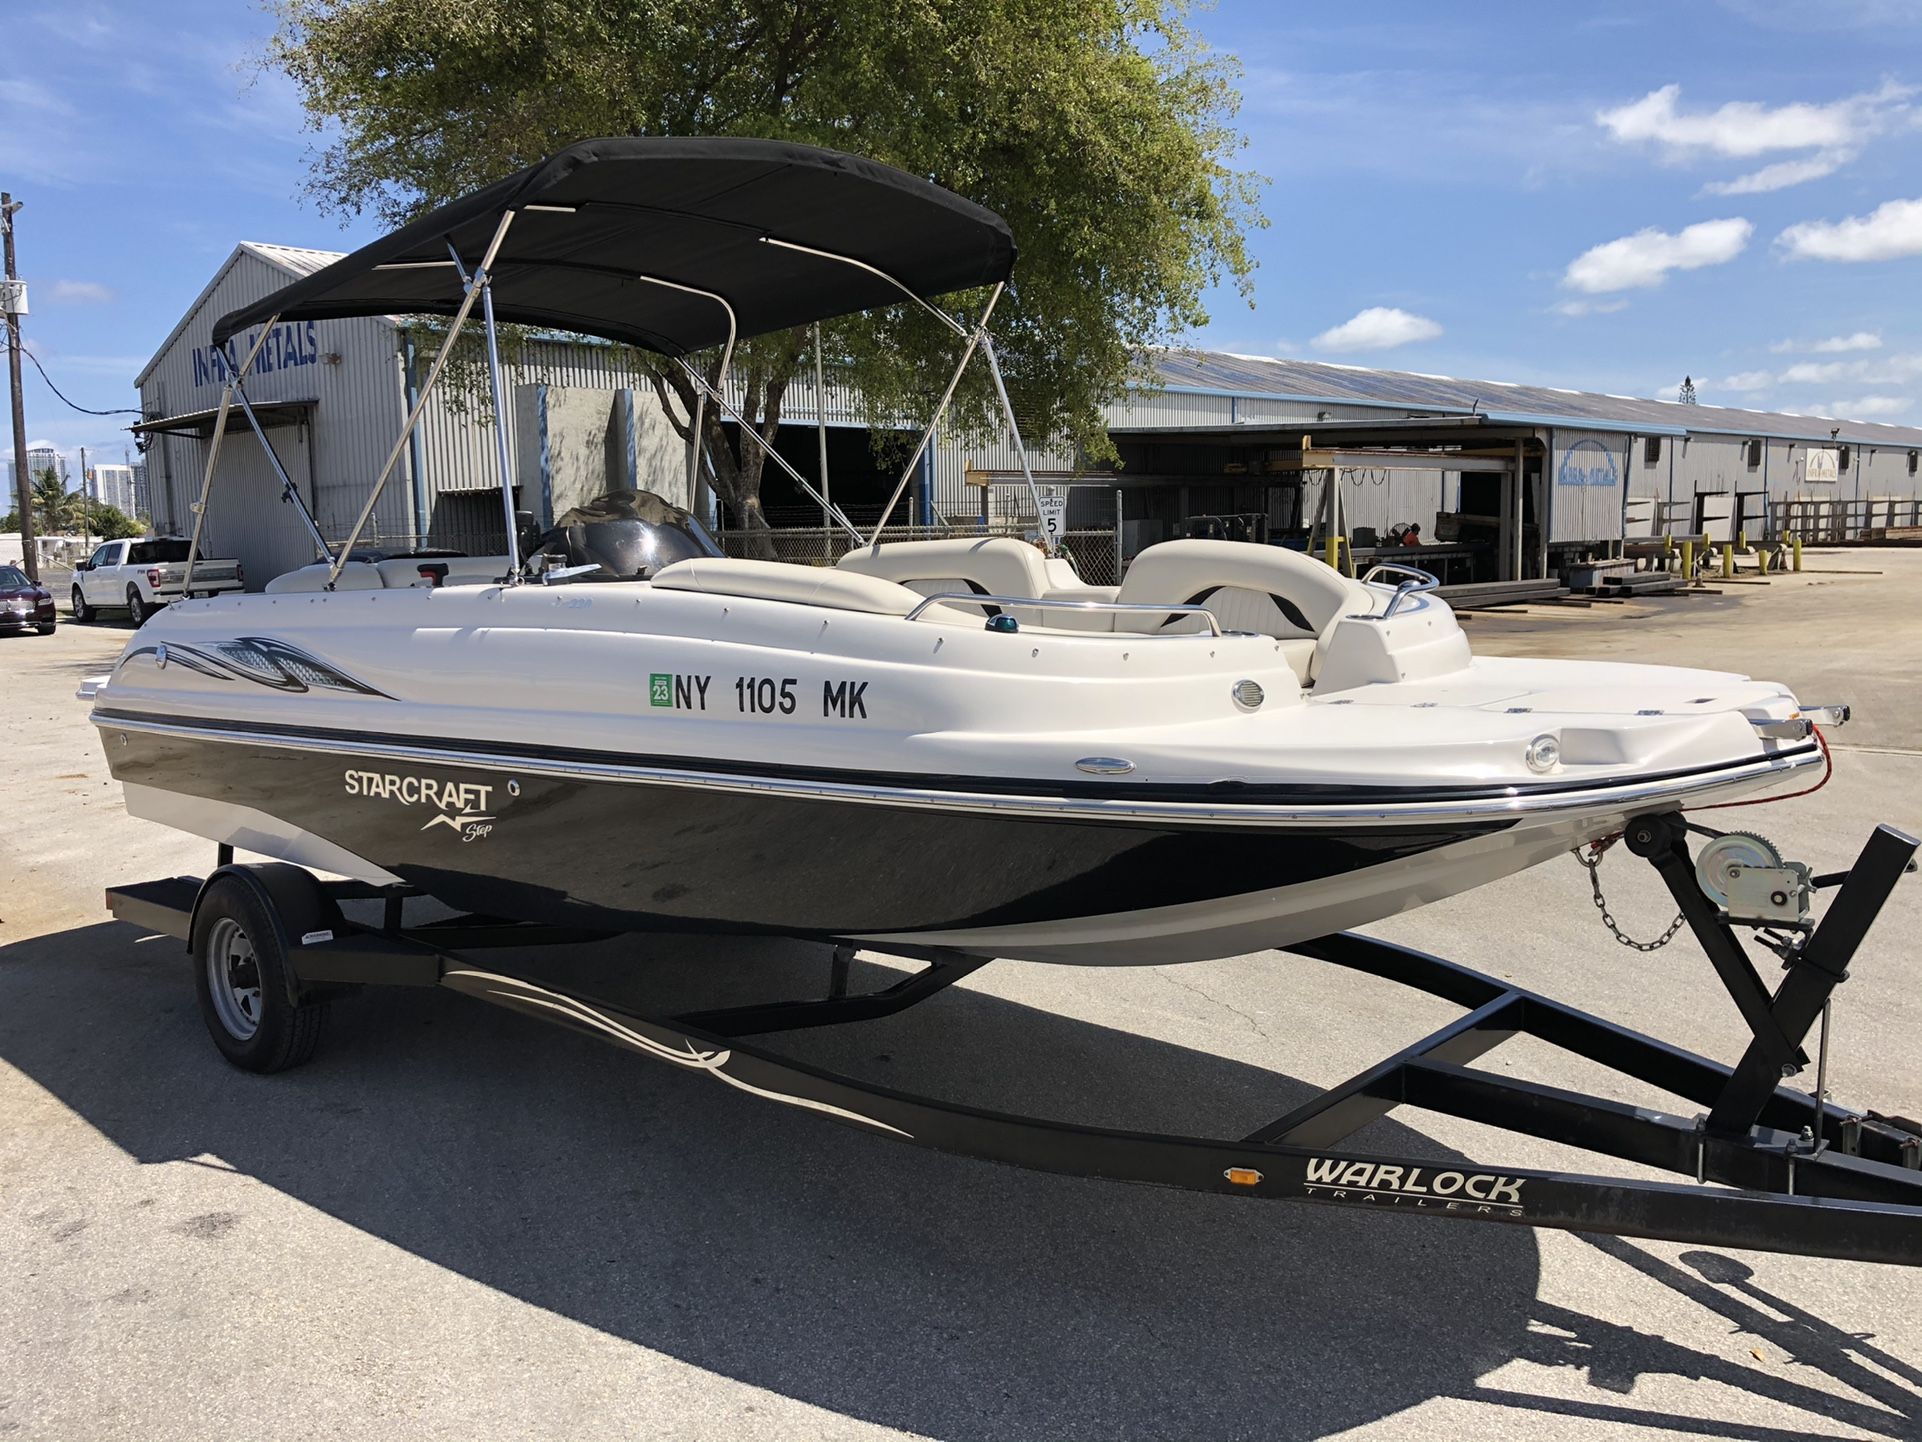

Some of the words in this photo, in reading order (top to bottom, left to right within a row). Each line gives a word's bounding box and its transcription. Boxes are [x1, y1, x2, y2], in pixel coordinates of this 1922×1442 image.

[249, 320, 318, 377] METALS
[1047, 518, 1057, 533] 5
[653, 685, 669, 701] 23
[676, 674, 712, 711] NY
[735, 676, 798, 715] 1105
[823, 680, 869, 719] MK
[344, 769, 494, 814] STARCRAFT
[462, 823, 493, 843] Step
[1306, 1157, 1528, 1203] WARLOCK
[1305, 1187, 1524, 1217] TRAILERS
